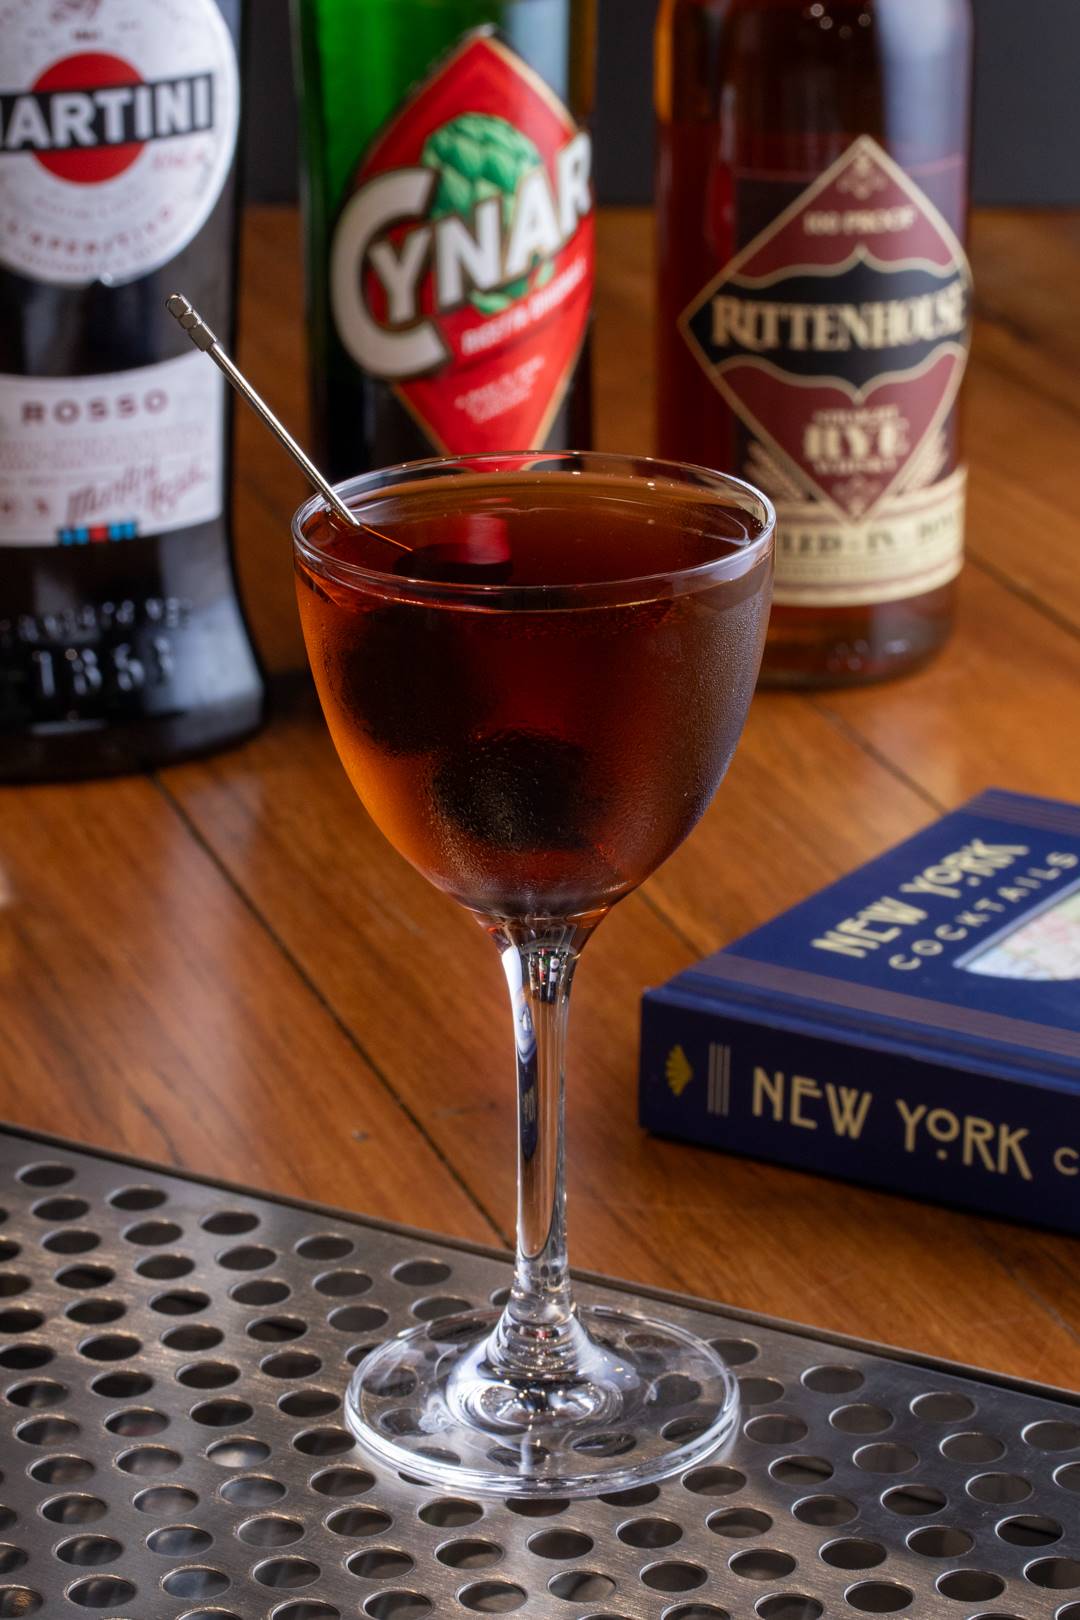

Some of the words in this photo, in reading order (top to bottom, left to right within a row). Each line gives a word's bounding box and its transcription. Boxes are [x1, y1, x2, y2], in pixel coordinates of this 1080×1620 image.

[0, 75, 209, 149] ARTINI
[331, 132, 592, 377] CYNAR
[712, 282, 966, 351] RITTENHOUSE
[21, 389, 168, 426] ROSSO
[810, 896, 928, 959] NEW
[899, 838, 1030, 899] YORK
[888, 851, 1079, 971] COCKTAILS
[751, 1066, 873, 1140] NEW
[896, 1098, 1033, 1181] YORK
